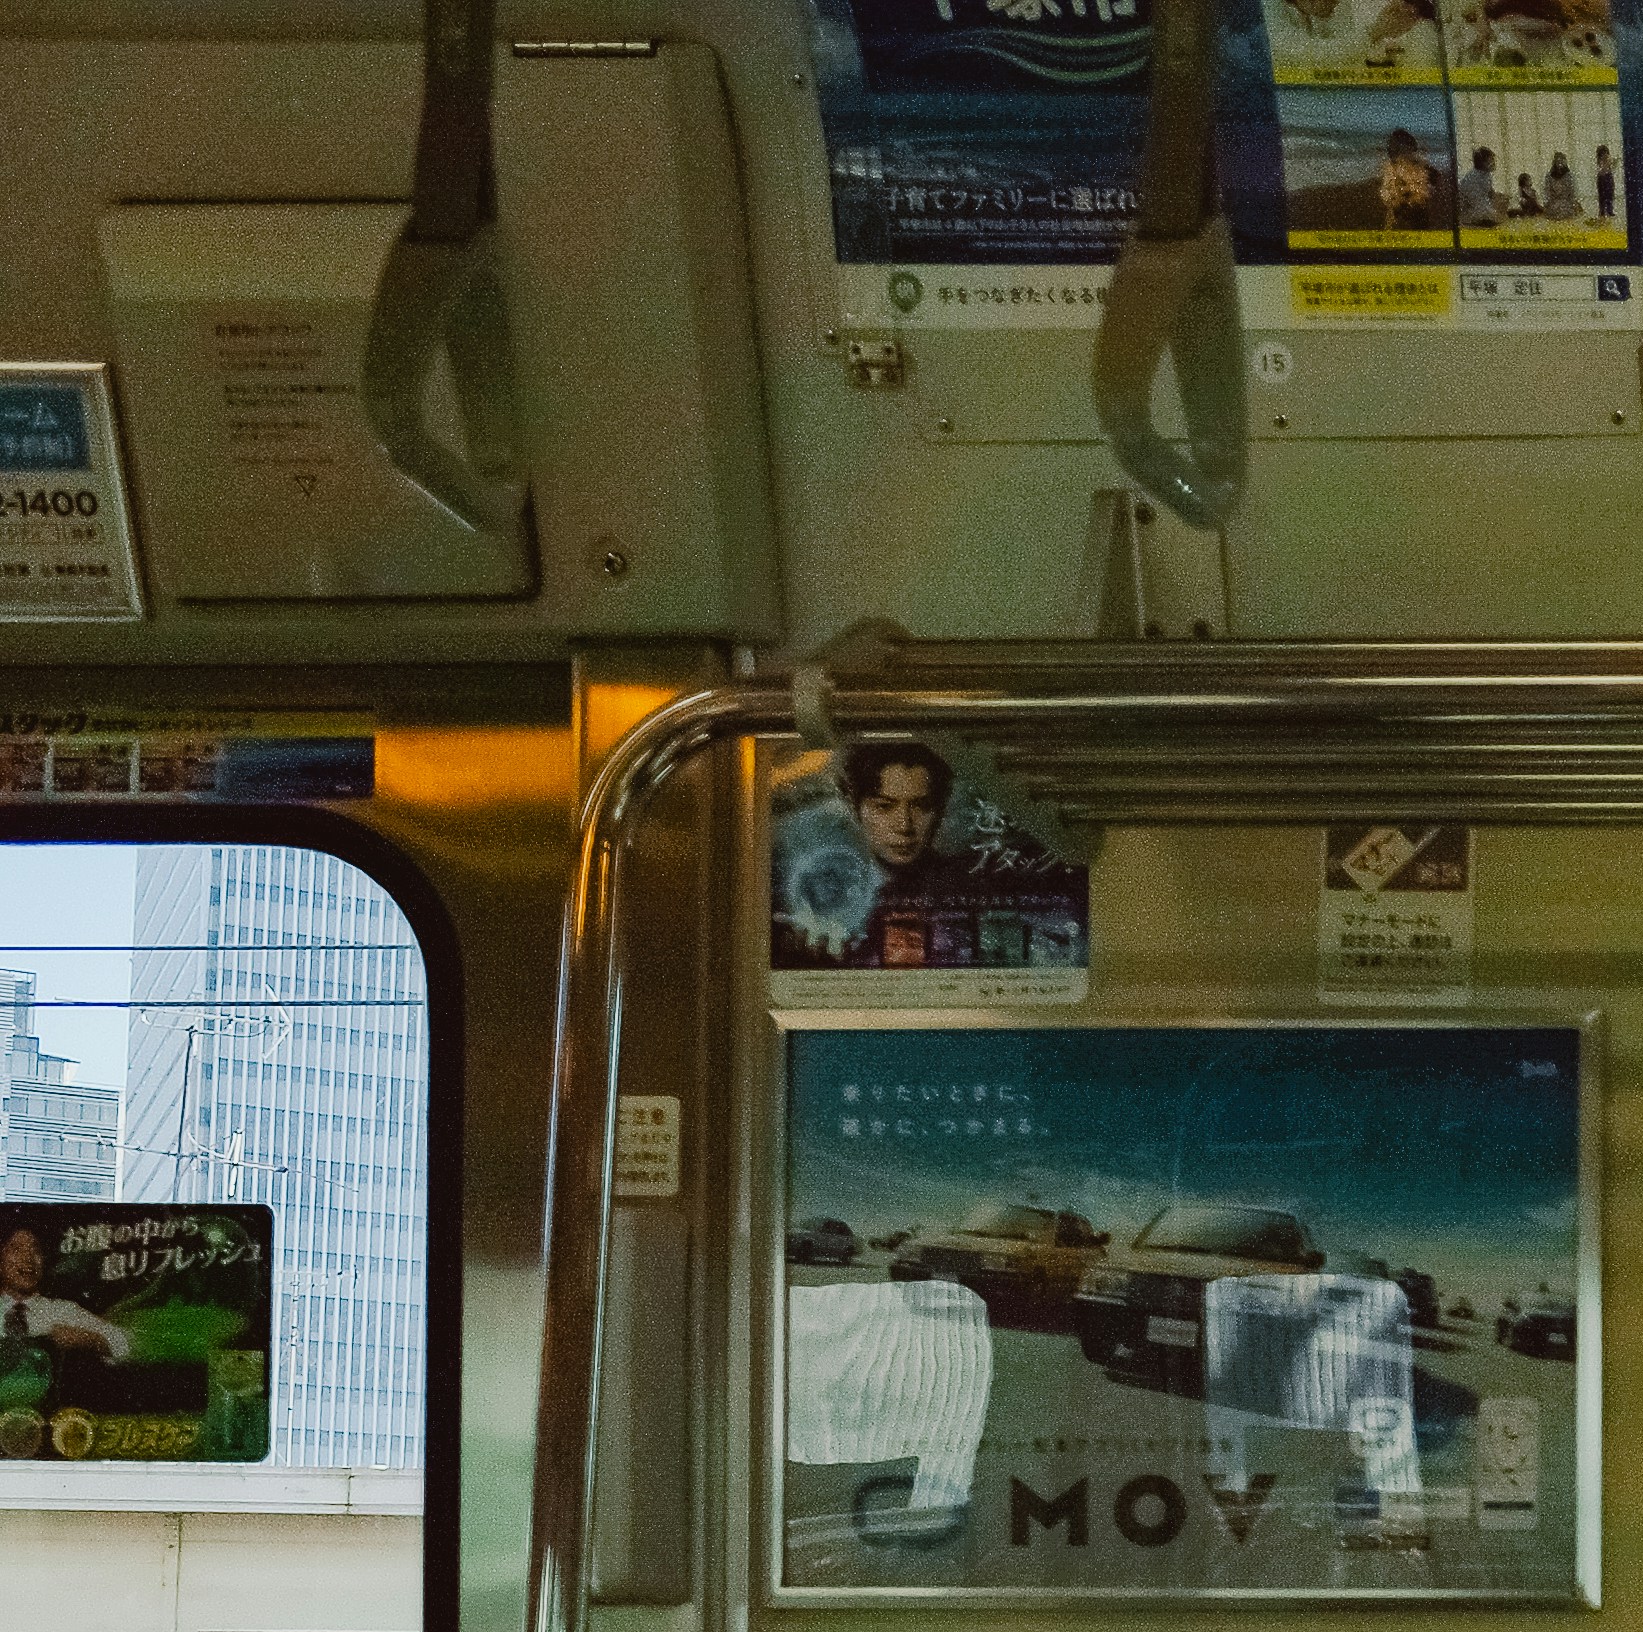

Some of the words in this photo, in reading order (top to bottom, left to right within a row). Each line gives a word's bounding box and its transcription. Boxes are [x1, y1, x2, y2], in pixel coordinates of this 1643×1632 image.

[939, 287, 1107, 304] 手をつなぎたくなる
[1260, 353, 1286, 373] 15
[1010, 1474, 1277, 1546] MOV
